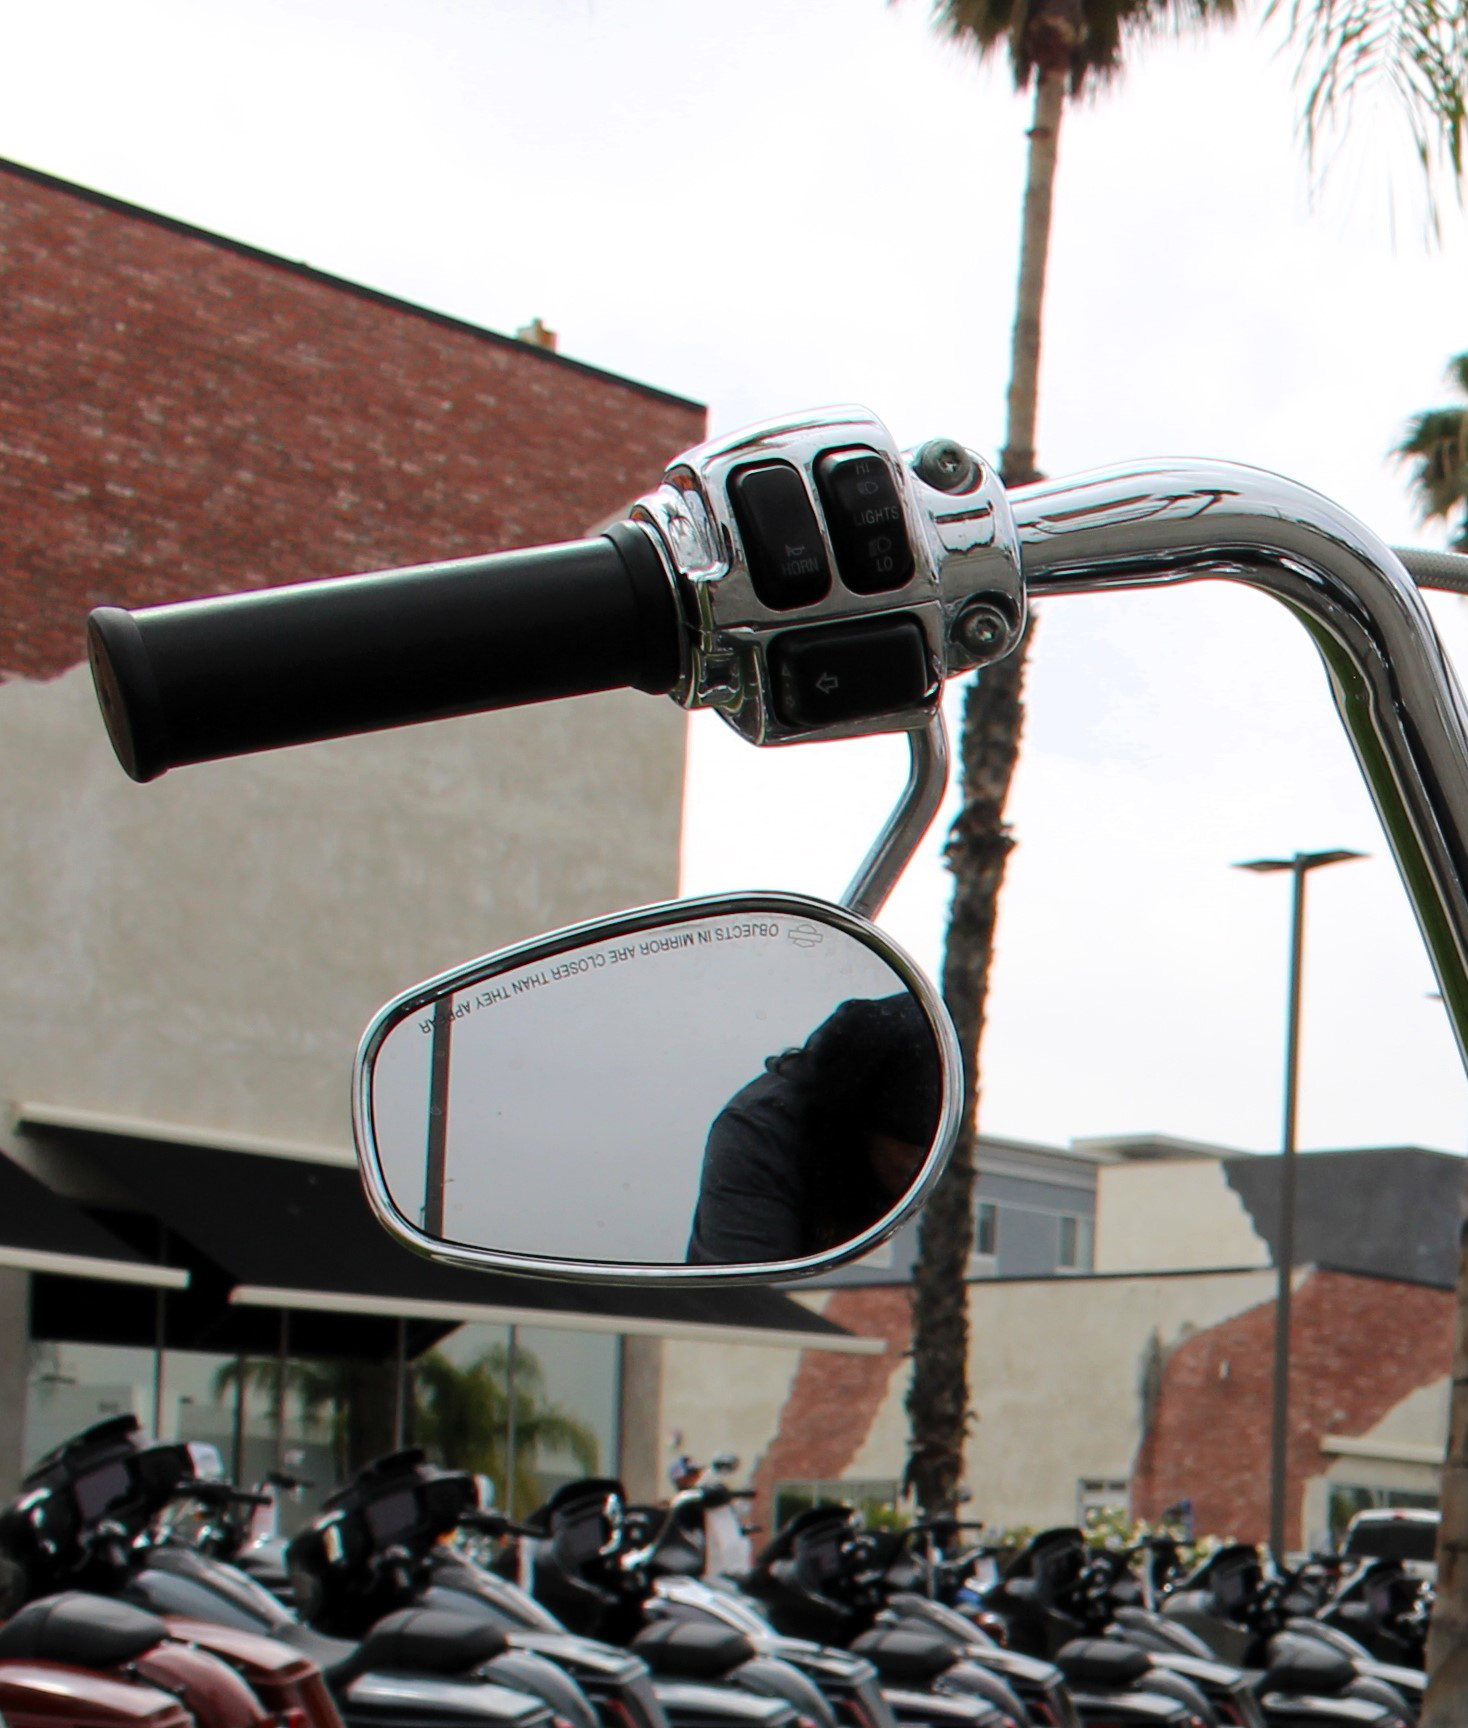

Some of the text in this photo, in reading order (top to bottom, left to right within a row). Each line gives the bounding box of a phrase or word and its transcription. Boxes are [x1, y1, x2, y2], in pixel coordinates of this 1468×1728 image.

[852, 506, 900, 528] LIGHTS
[781, 556, 819, 578] HORN
[875, 555, 894, 573] LO
[698, 929, 713, 945] IN
[715, 922, 780, 942] OBJECTS
[609, 945, 636, 965] ARE
[639, 932, 696, 957] MIRROR
[550, 952, 606, 981] CLOSER
[510, 970, 550, 996] THAN
[475, 989, 511, 1011] THEY
